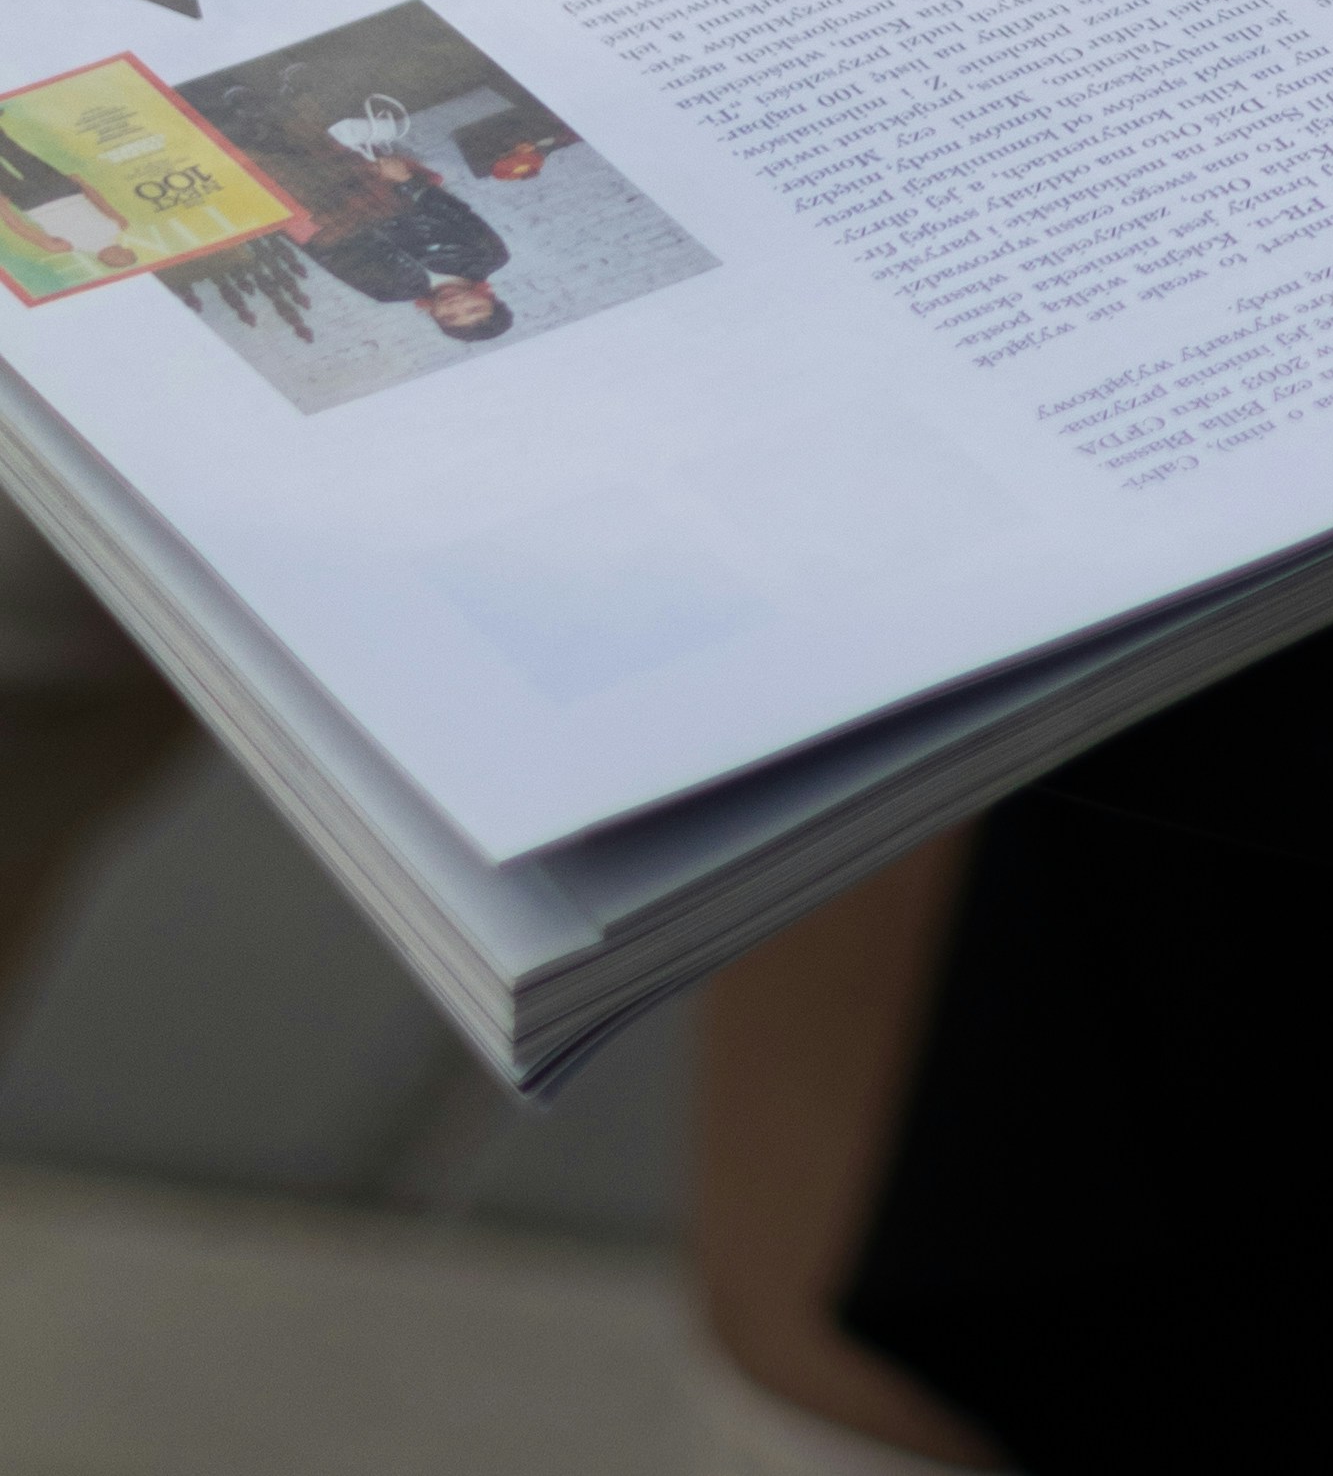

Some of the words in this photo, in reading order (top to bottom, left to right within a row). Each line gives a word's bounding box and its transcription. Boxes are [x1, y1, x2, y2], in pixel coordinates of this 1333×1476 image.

[1200, 150, 1249, 173] ona
[1255, 135, 1296, 153] To
[1120, 170, 1197, 206] swego
[1227, 174, 1319, 216] branży
[1017, 205, 1171, 272] założycielka
[1042, 204, 1114, 238] czasu
[1167, 208, 1220, 238] jest
[1031, 235, 1161, 292] niemiecka
[1132, 230, 1240, 275] Kolejną
[1218, 252, 1248, 268] to
[909, 272, 1009, 318] własnej
[1039, 275, 1128, 313] wielką
[1136, 268, 1209, 301] wcale
[1086, 299, 1127, 321] nie
[971, 321, 1077, 368] wyjątek
[1179, 311, 1290, 362] wywarły
[1273, 323, 1313, 350] jej
[1172, 343, 1275, 389] imienia
[1239, 354, 1310, 392] 2003
[1035, 359, 1174, 420] wyjątkowy
[1169, 385, 1233, 416] roku
[1271, 378, 1313, 403] czy
[1197, 398, 1267, 431] Billa
[1074, 416, 1166, 456] CFDA
